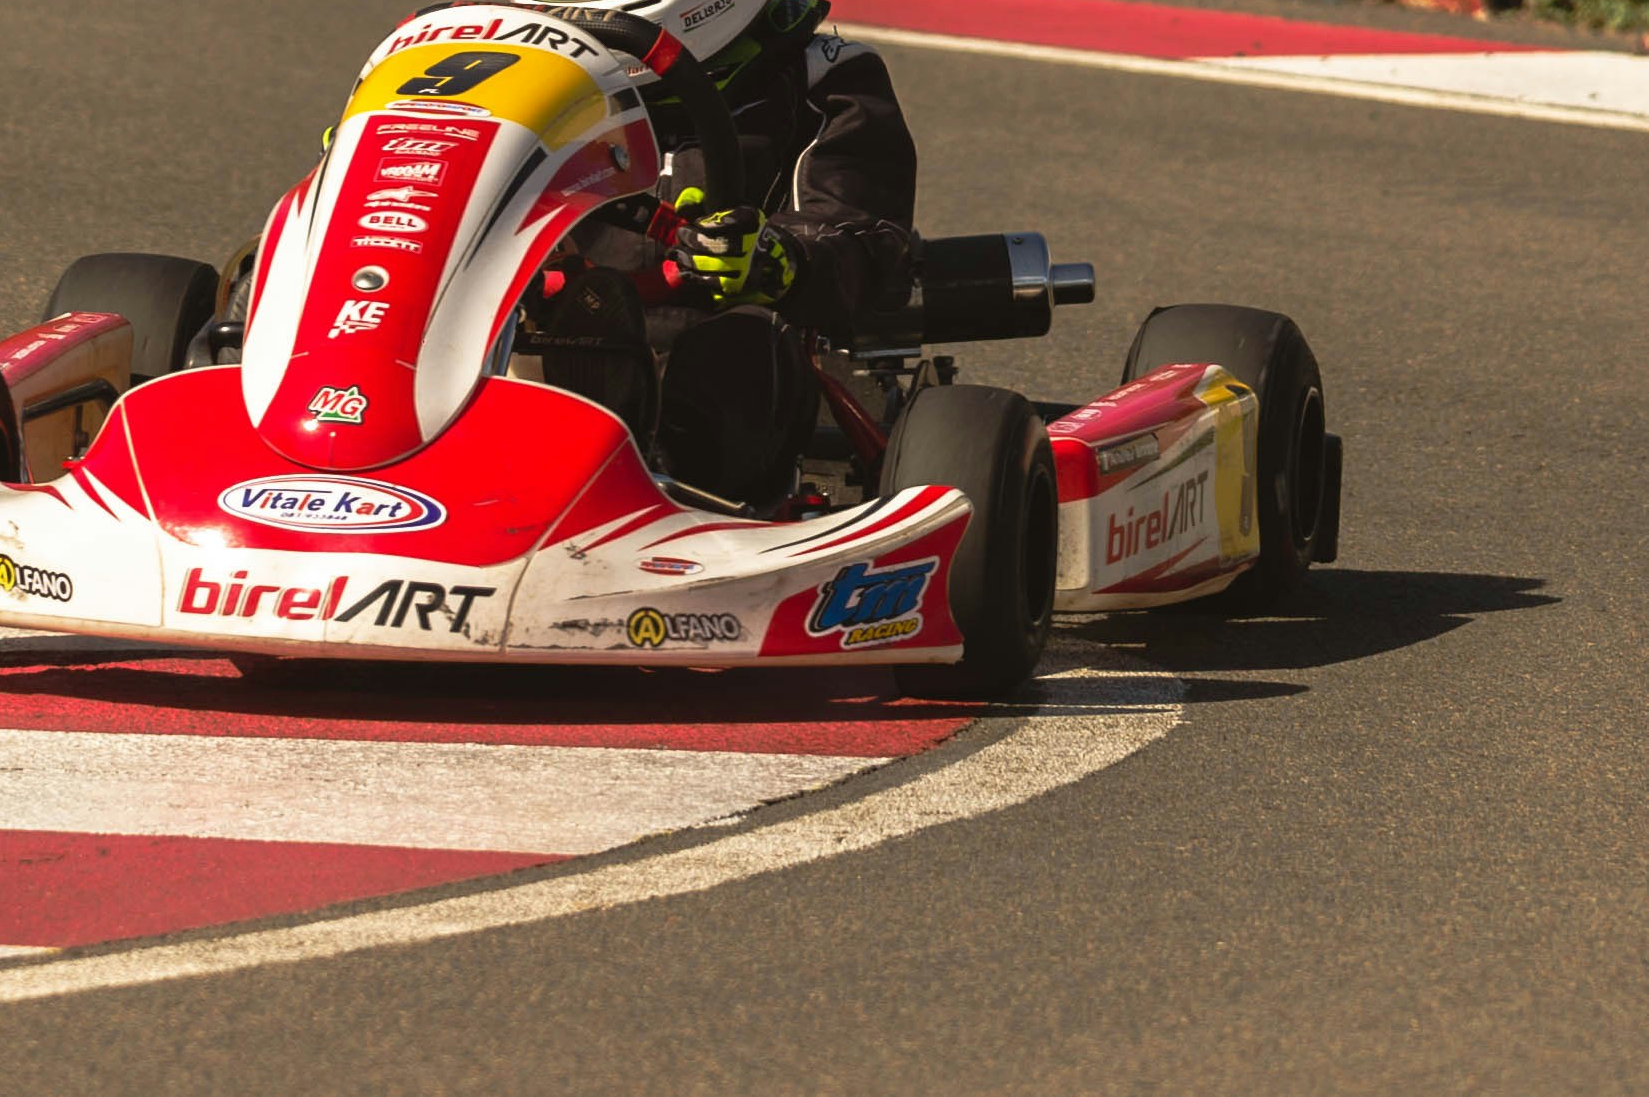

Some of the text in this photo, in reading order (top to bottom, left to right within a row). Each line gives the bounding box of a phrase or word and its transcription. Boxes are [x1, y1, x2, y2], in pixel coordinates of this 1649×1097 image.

[396, 51, 521, 96] 9
[377, 123, 481, 139] FREELINE
[369, 215, 418, 228] BELL
[312, 390, 363, 417] MG
[240, 488, 402, 519] Vitale Kart
[1106, 469, 1209, 566] birelART
[177, 567, 498, 634] birelART
[627, 606, 744, 648] ALFANO
[843, 617, 919, 646] RACING
